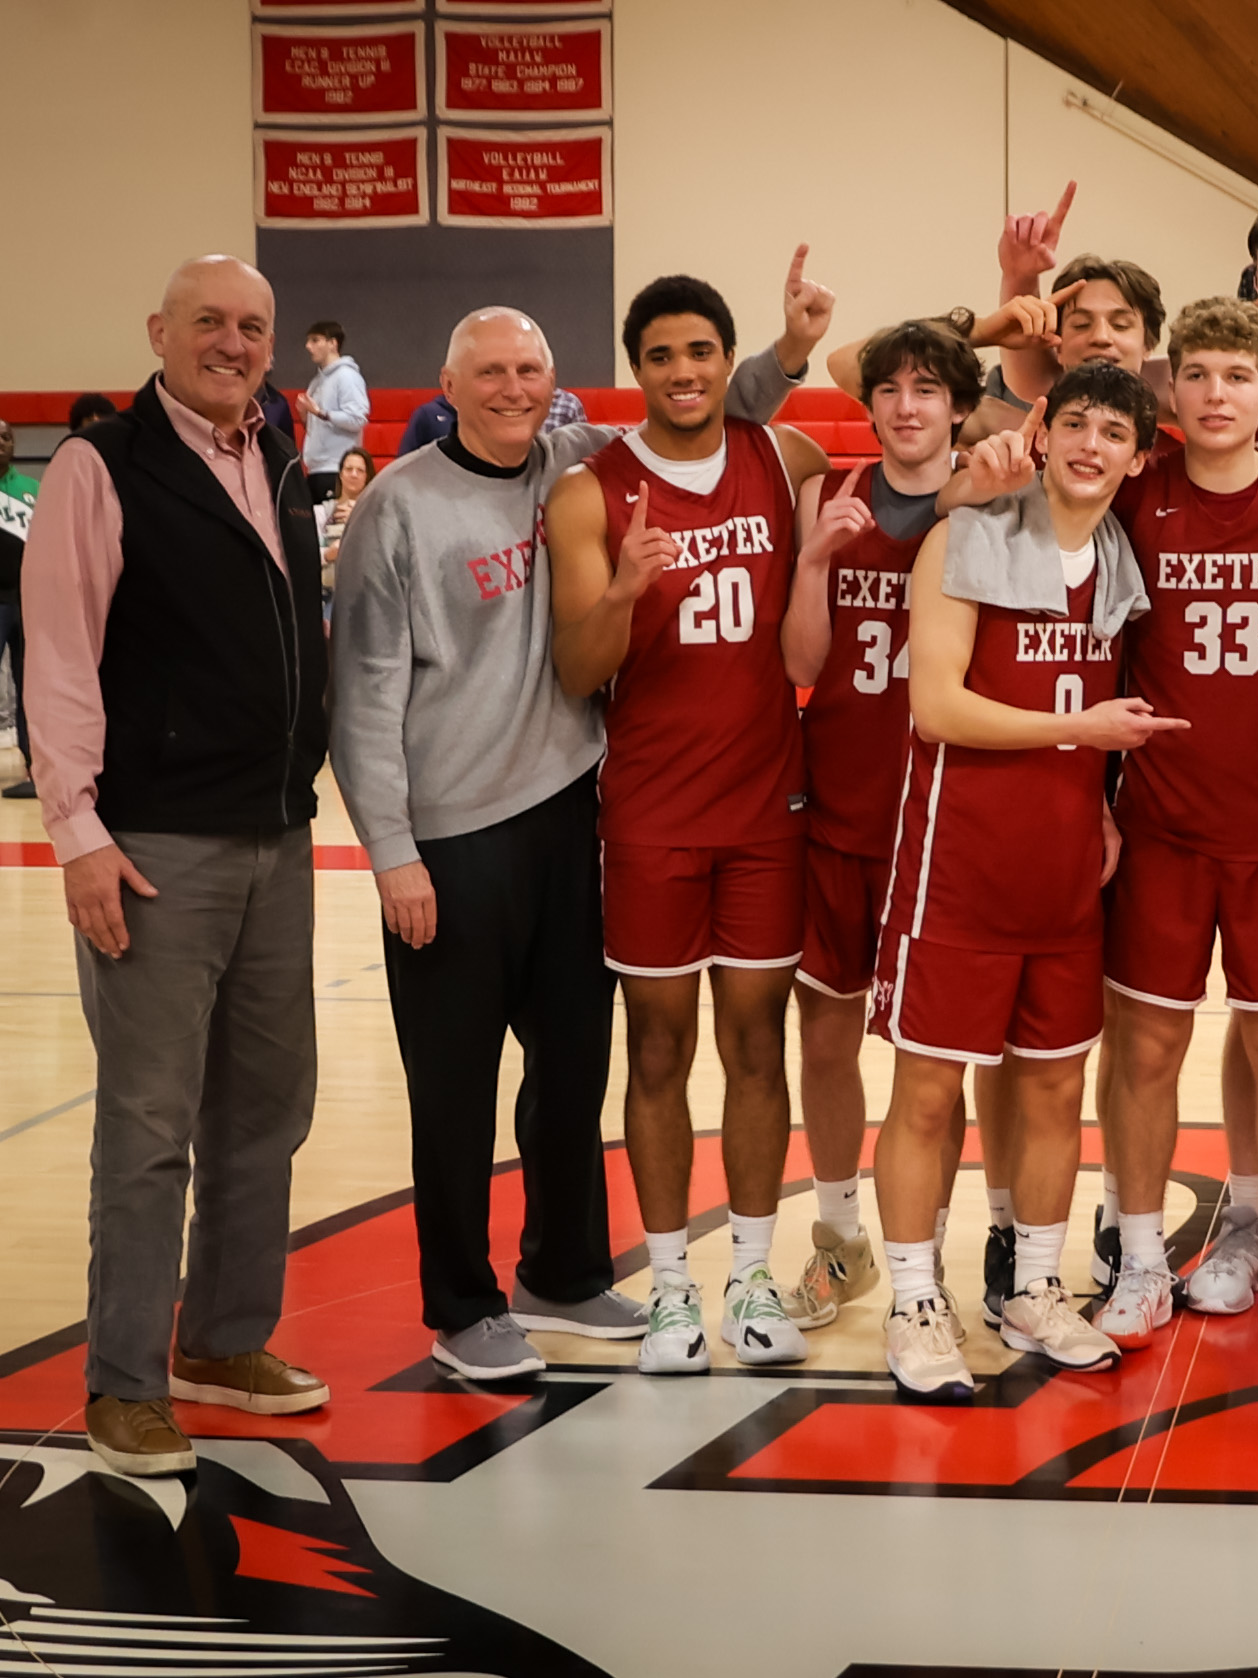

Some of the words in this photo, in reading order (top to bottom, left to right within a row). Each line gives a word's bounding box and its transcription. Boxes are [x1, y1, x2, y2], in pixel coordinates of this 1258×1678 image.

[342, 44, 387, 59] TENNIS
[344, 151, 384, 165] TENNIS
[482, 151, 565, 165] VOLLEYBALL
[662, 515, 774, 570] XETER
[837, 568, 911, 610] EXET
[679, 566, 755, 645] 20
